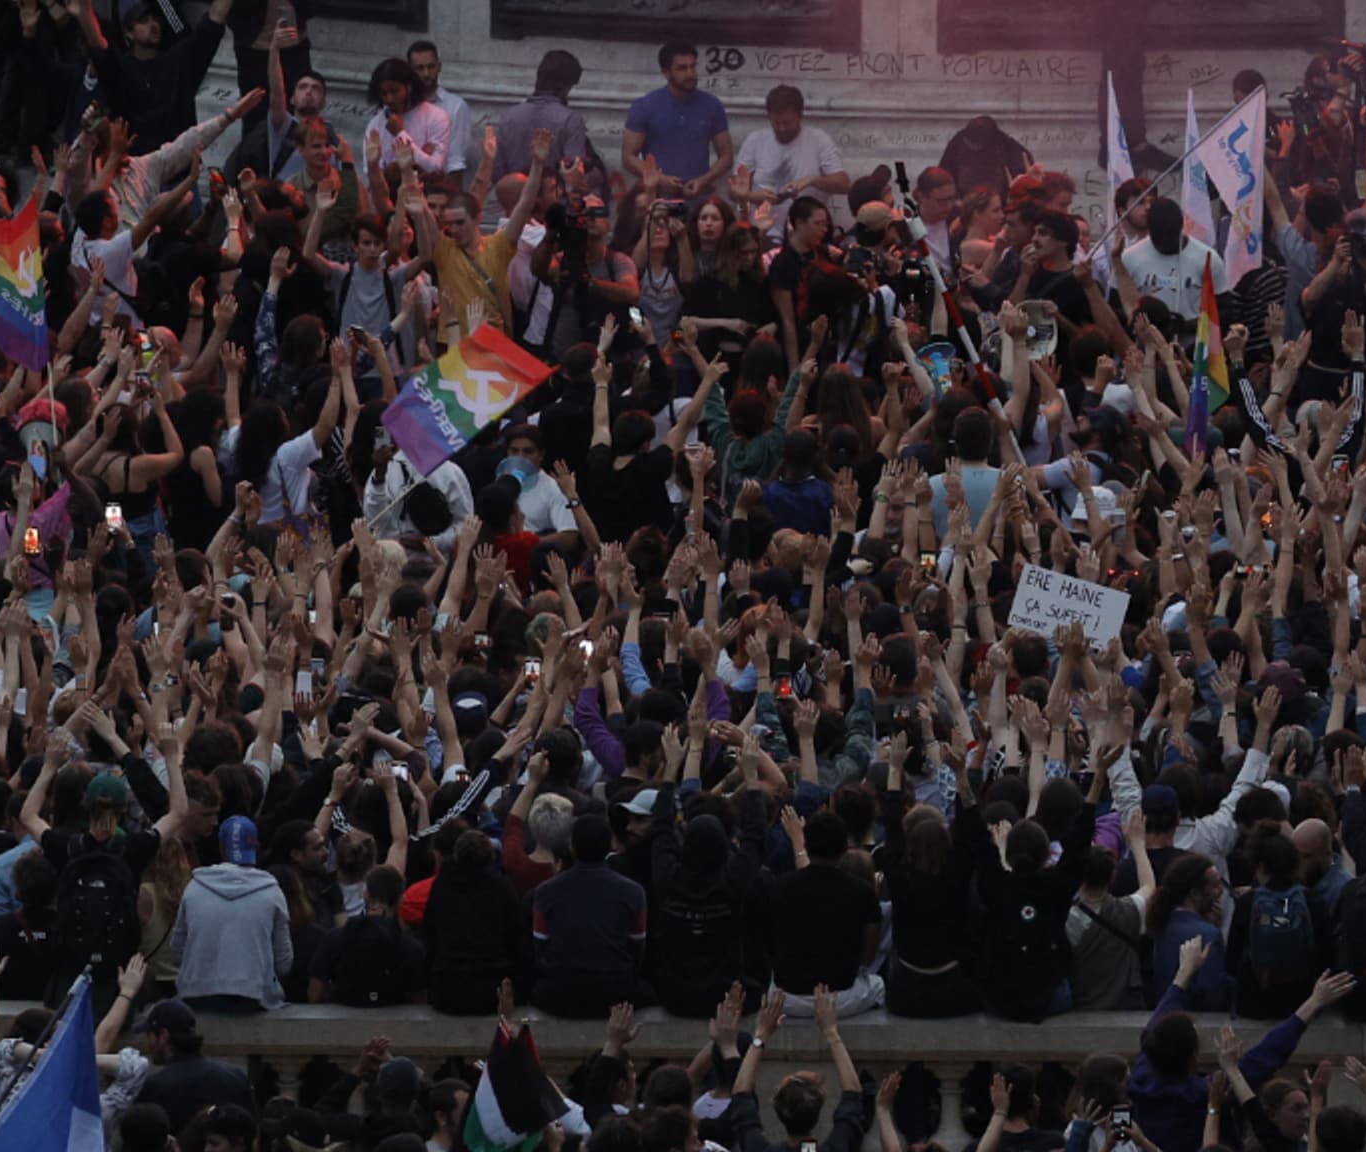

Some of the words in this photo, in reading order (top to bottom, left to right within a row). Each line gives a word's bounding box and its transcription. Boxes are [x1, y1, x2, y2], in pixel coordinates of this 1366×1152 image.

[705, 46, 745, 74] 30
[756, 52, 832, 73] VOTEZ
[847, 51, 925, 76] FRONT
[941, 55, 1088, 80] POPULAIRE
